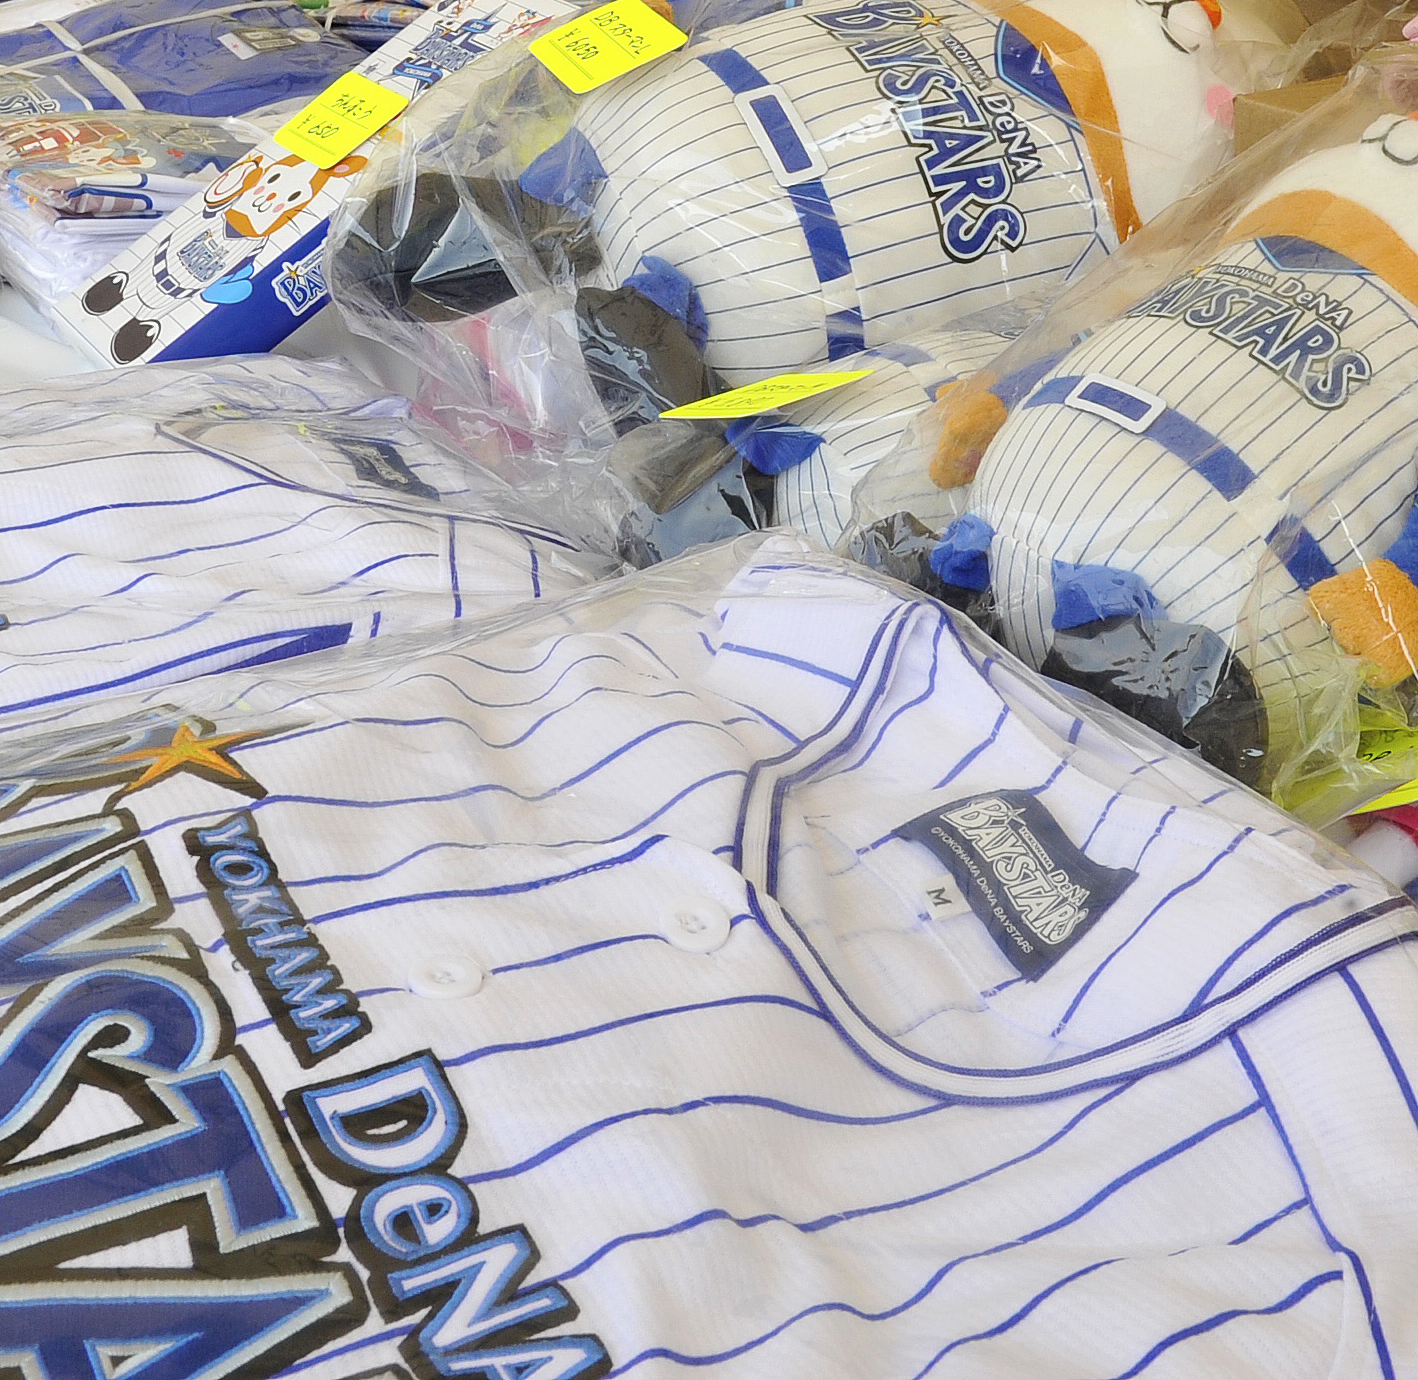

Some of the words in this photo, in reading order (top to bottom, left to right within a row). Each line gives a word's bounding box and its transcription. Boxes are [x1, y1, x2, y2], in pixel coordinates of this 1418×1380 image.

[807, 0, 1027, 264] BAYSTARS
[980, 86, 1044, 182] DeNA
[1275, 271, 1352, 331] DeNA
[925, 887, 953, 908] M
[939, 795, 1091, 946] BAYSTARS
[1049, 867, 1092, 907] DeNA
[976, 876, 998, 907] DeNA
[993, 905, 1035, 955] BAYSTARS
